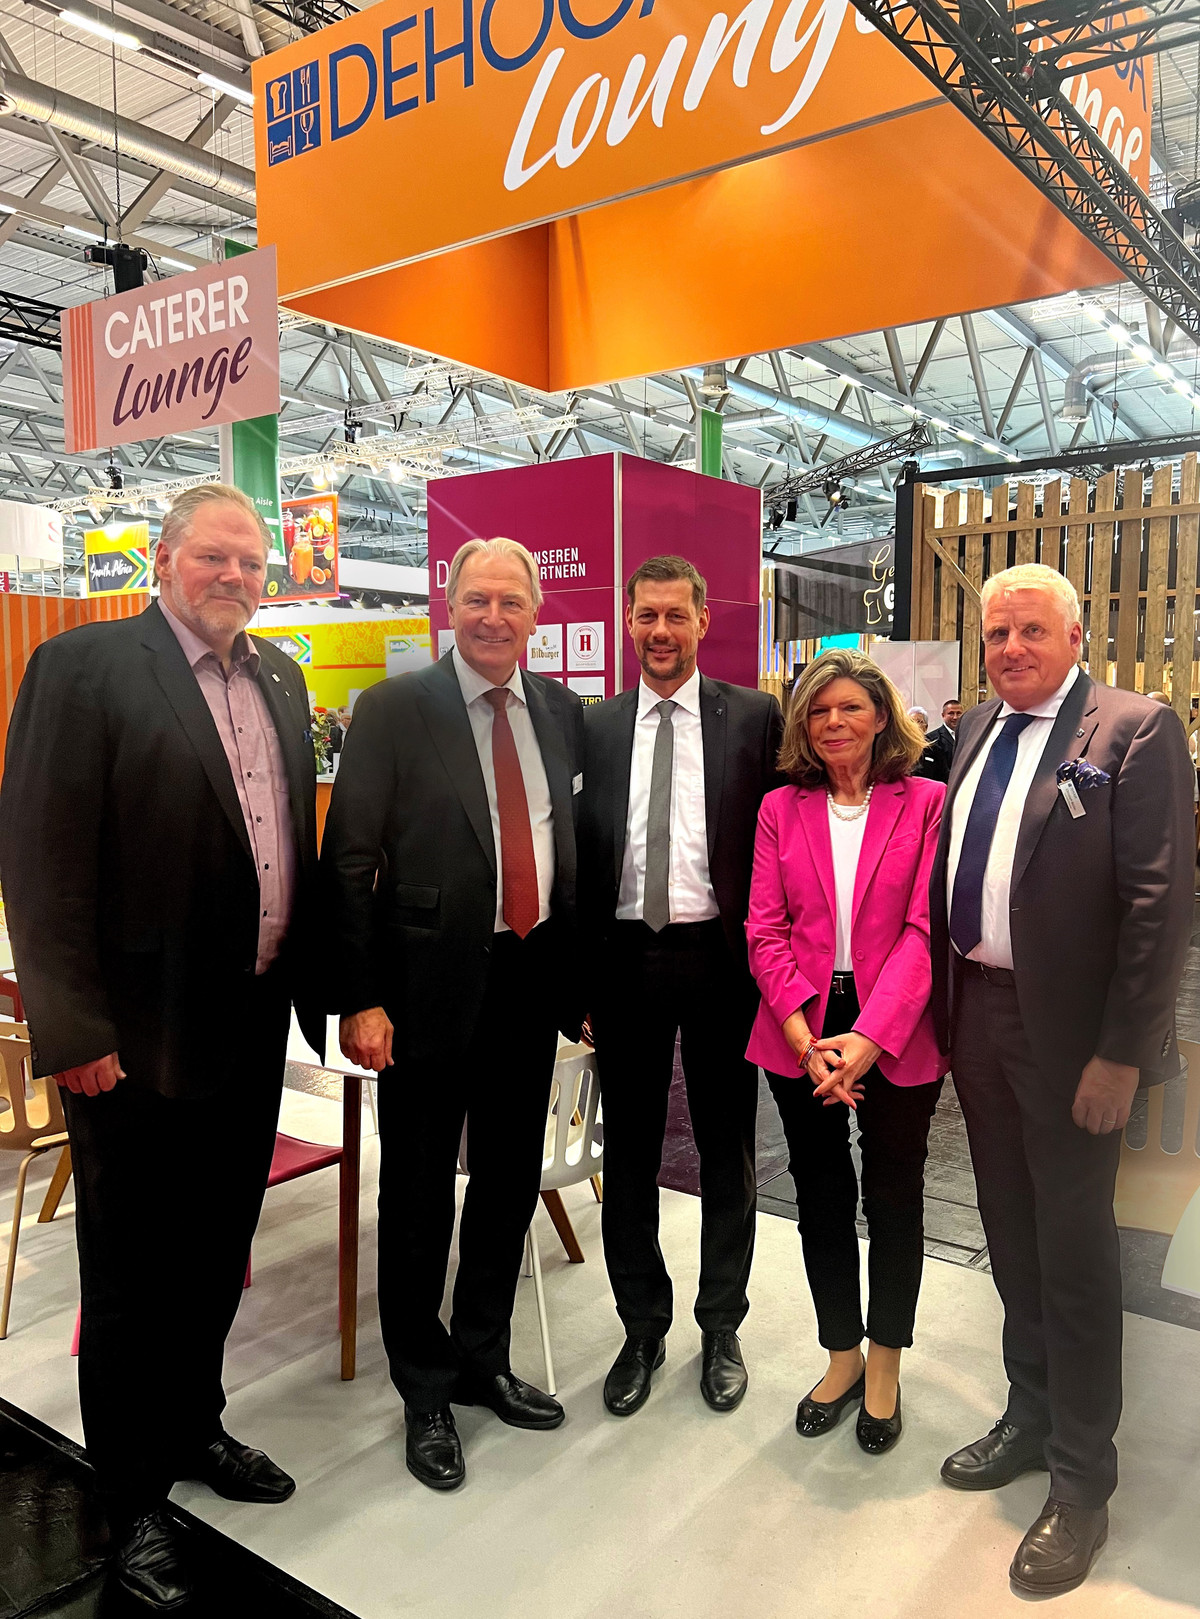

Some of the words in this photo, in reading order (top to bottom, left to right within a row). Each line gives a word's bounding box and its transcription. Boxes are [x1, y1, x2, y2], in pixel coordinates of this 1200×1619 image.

[104, 275, 250, 359] CATERER
[112, 336, 253, 427] Lounge
[255, 496, 274, 507] Aisle
[540, 563, 586, 580] RTNERN
[580, 697, 602, 706] ETRO
